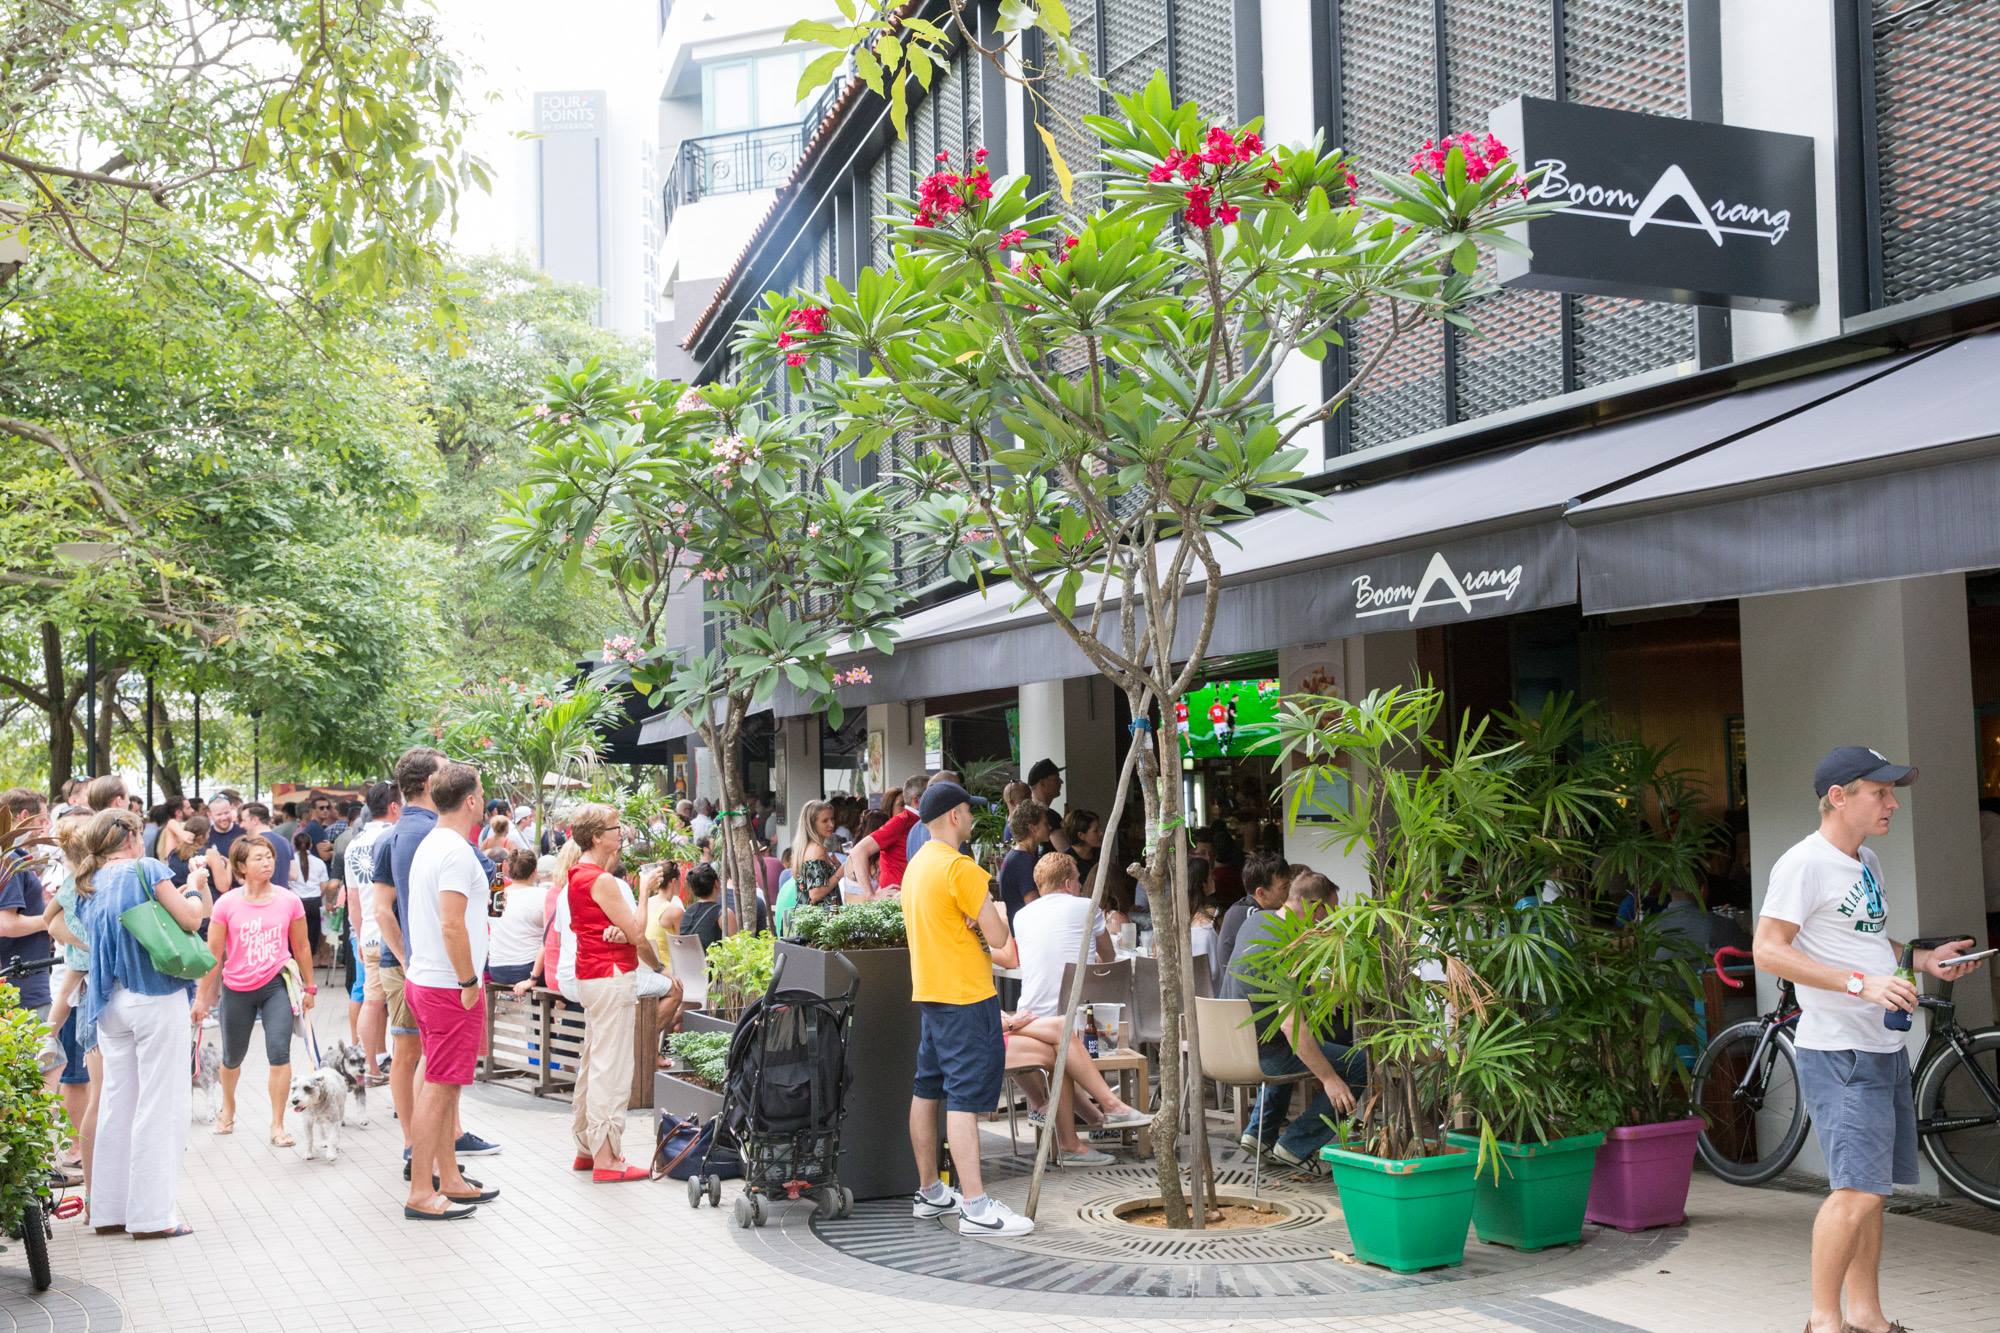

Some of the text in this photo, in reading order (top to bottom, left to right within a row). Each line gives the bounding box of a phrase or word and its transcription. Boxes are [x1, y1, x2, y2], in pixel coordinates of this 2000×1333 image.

[541, 95, 580, 109] FOUR
[541, 108, 595, 122] POINTS
[1534, 158, 1791, 248] BoomArang
[1351, 551, 1523, 623] BoomArang
